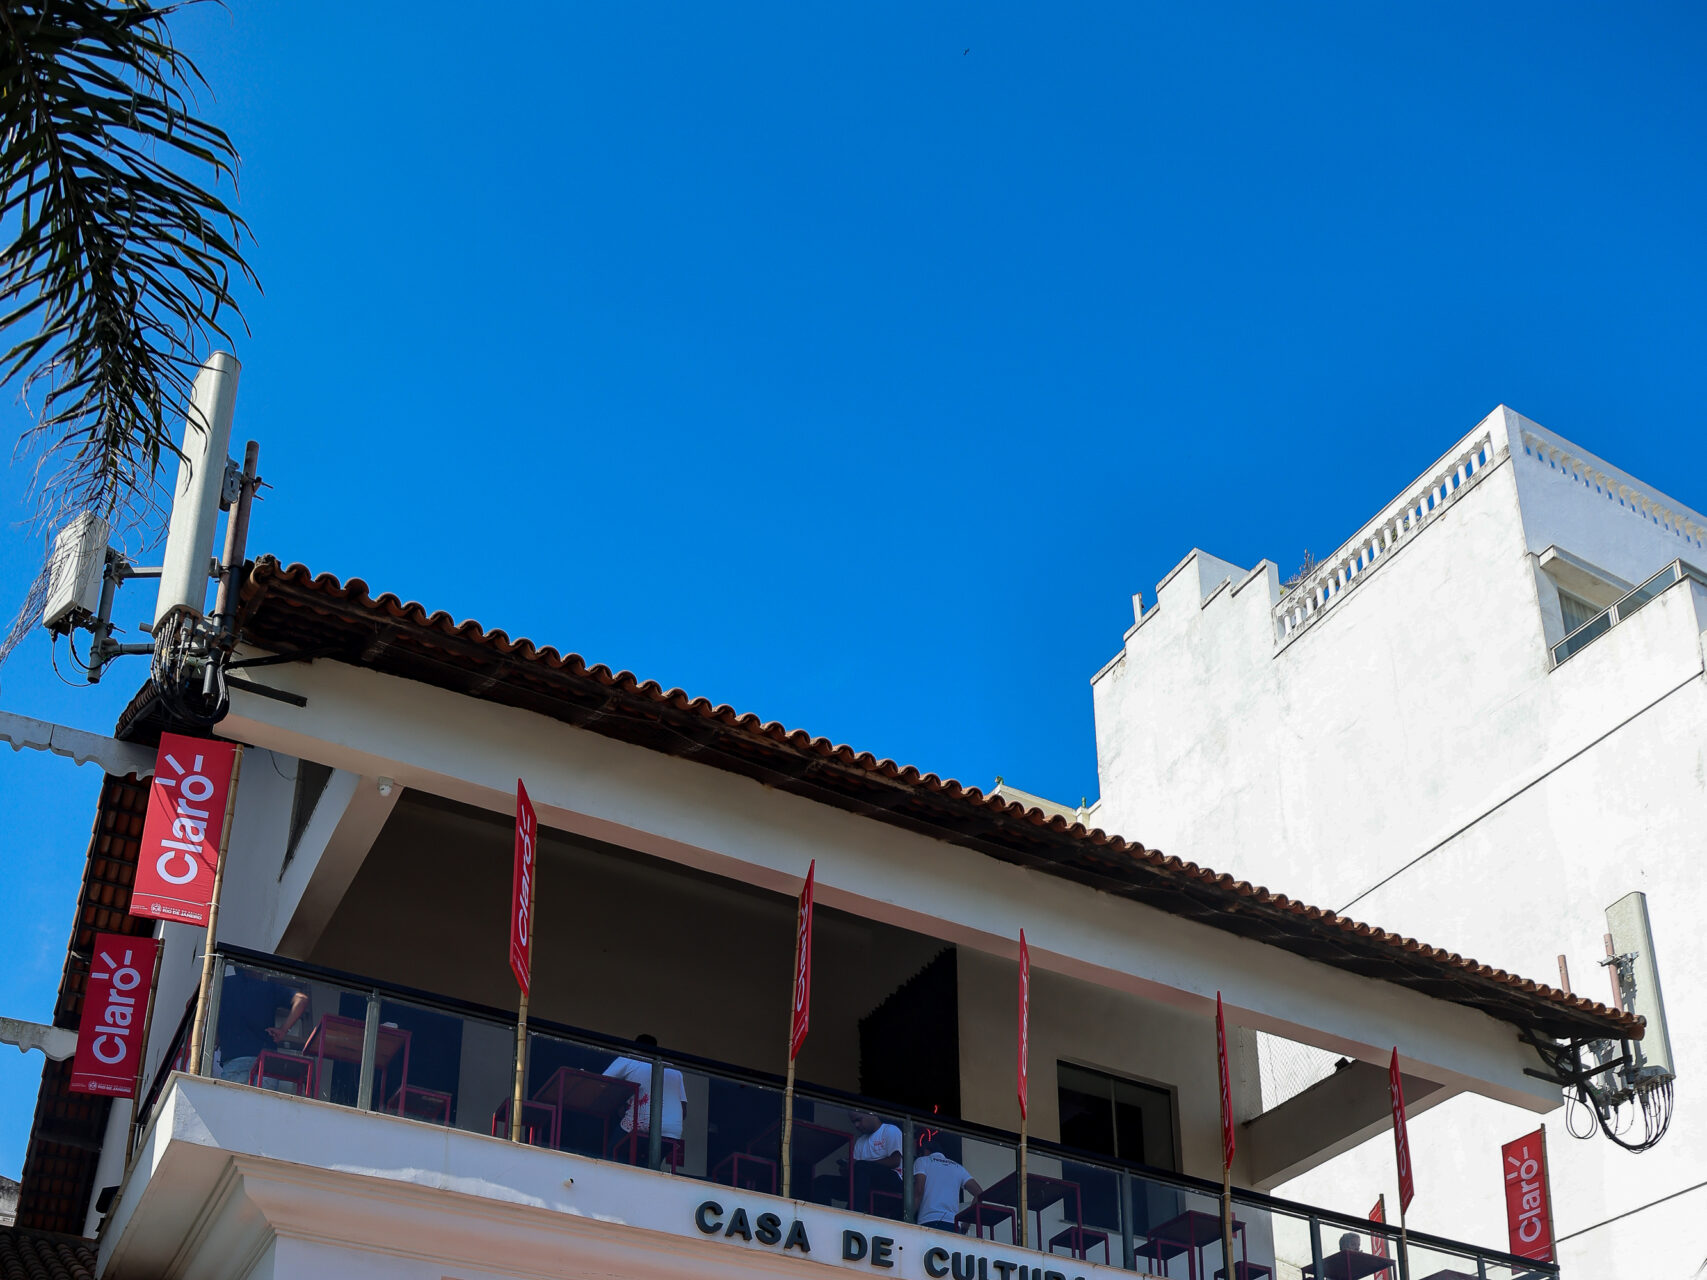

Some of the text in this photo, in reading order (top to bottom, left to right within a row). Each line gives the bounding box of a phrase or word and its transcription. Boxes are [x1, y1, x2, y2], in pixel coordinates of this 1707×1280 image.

[155, 762, 214, 885] Claro
[518, 818, 532, 947] Claro
[92, 957, 141, 1066] Claro
[695, 1200, 811, 1253] CASA
[842, 1229, 895, 1268] DE
[1511, 1152, 1541, 1243] Claro
